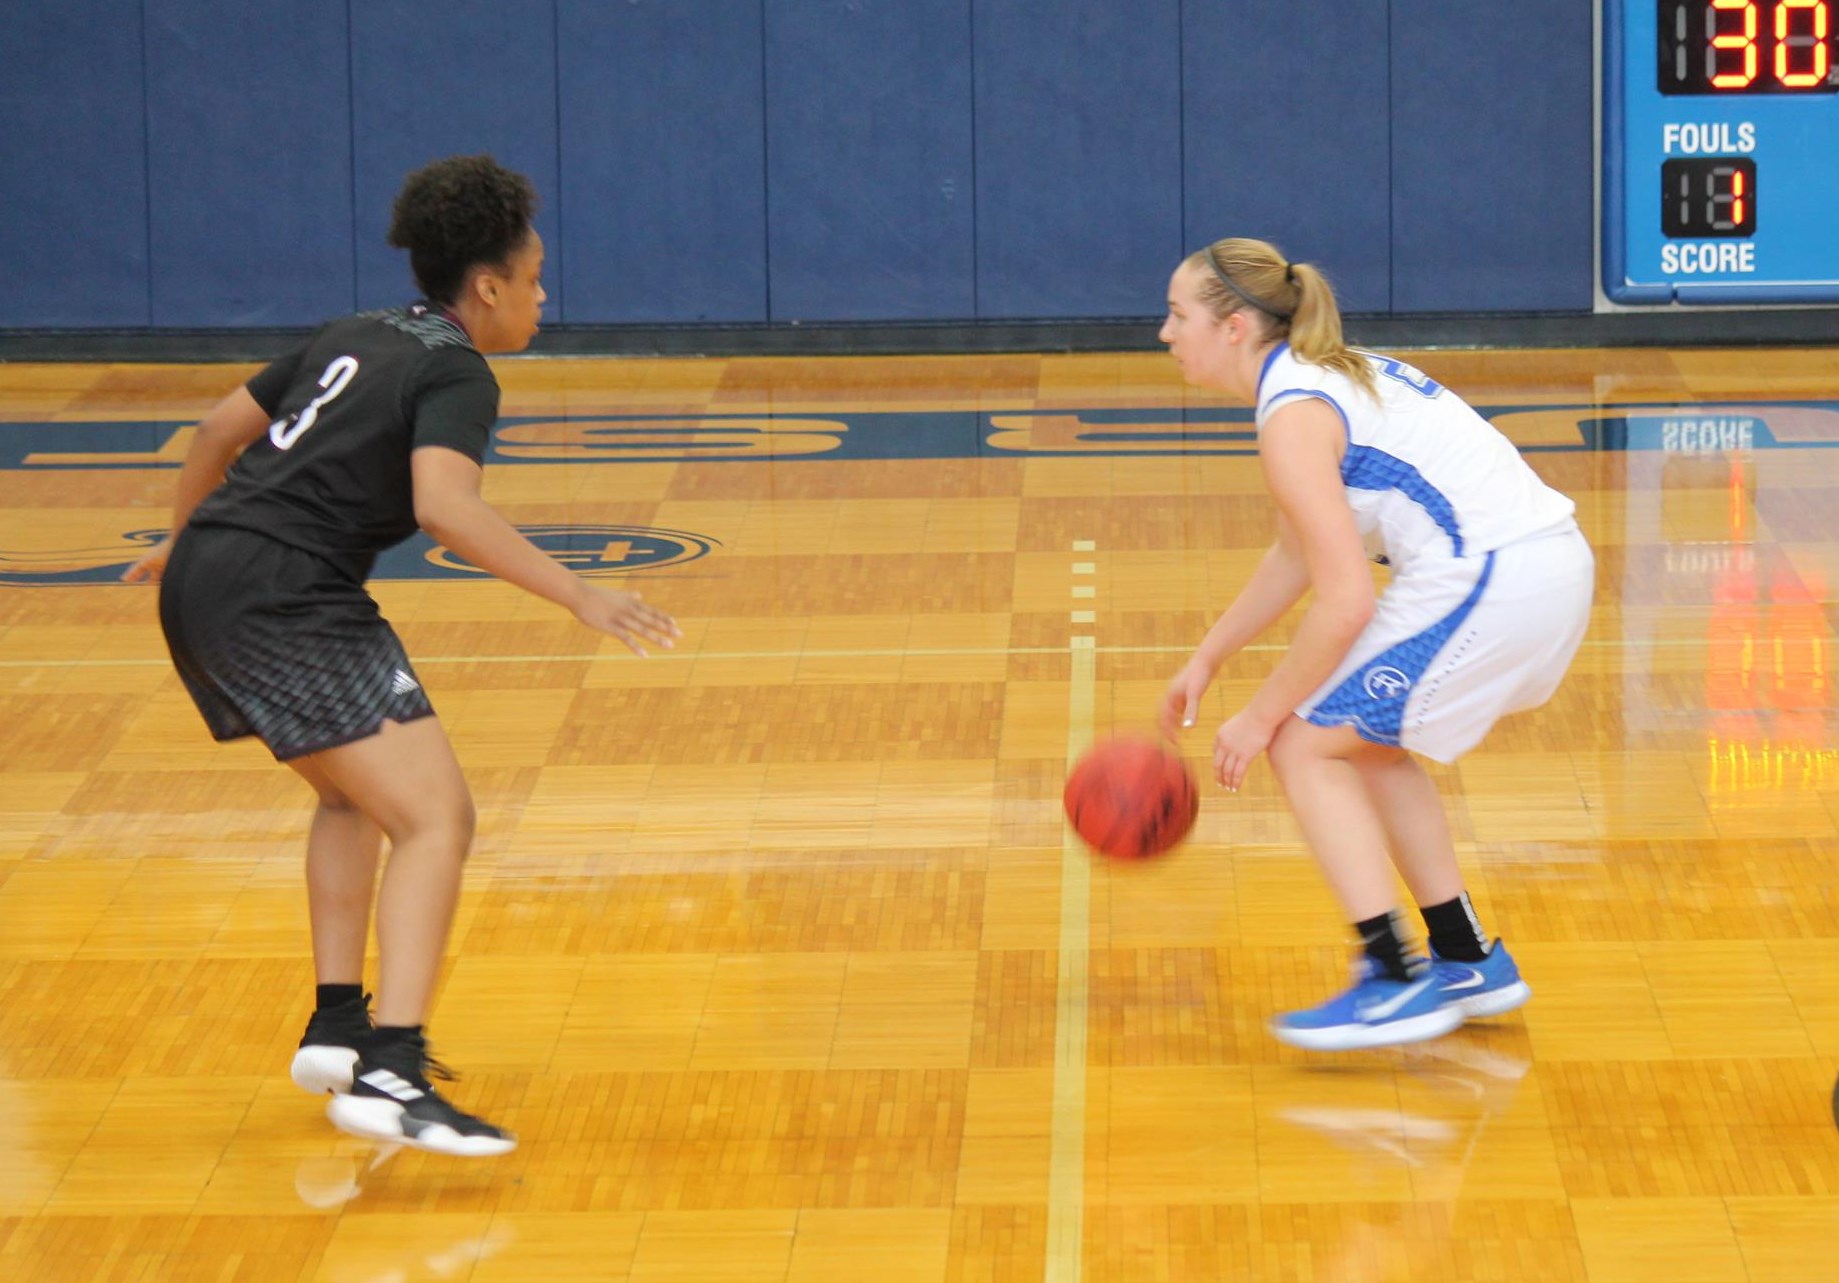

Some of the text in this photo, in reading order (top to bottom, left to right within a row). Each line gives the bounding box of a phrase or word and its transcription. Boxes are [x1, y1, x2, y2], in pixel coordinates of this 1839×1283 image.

[1710, 0, 1828, 88] 30
[1662, 122, 1756, 154] FOULS
[1660, 242, 1756, 274] SCORE
[269, 355, 360, 451] 3
